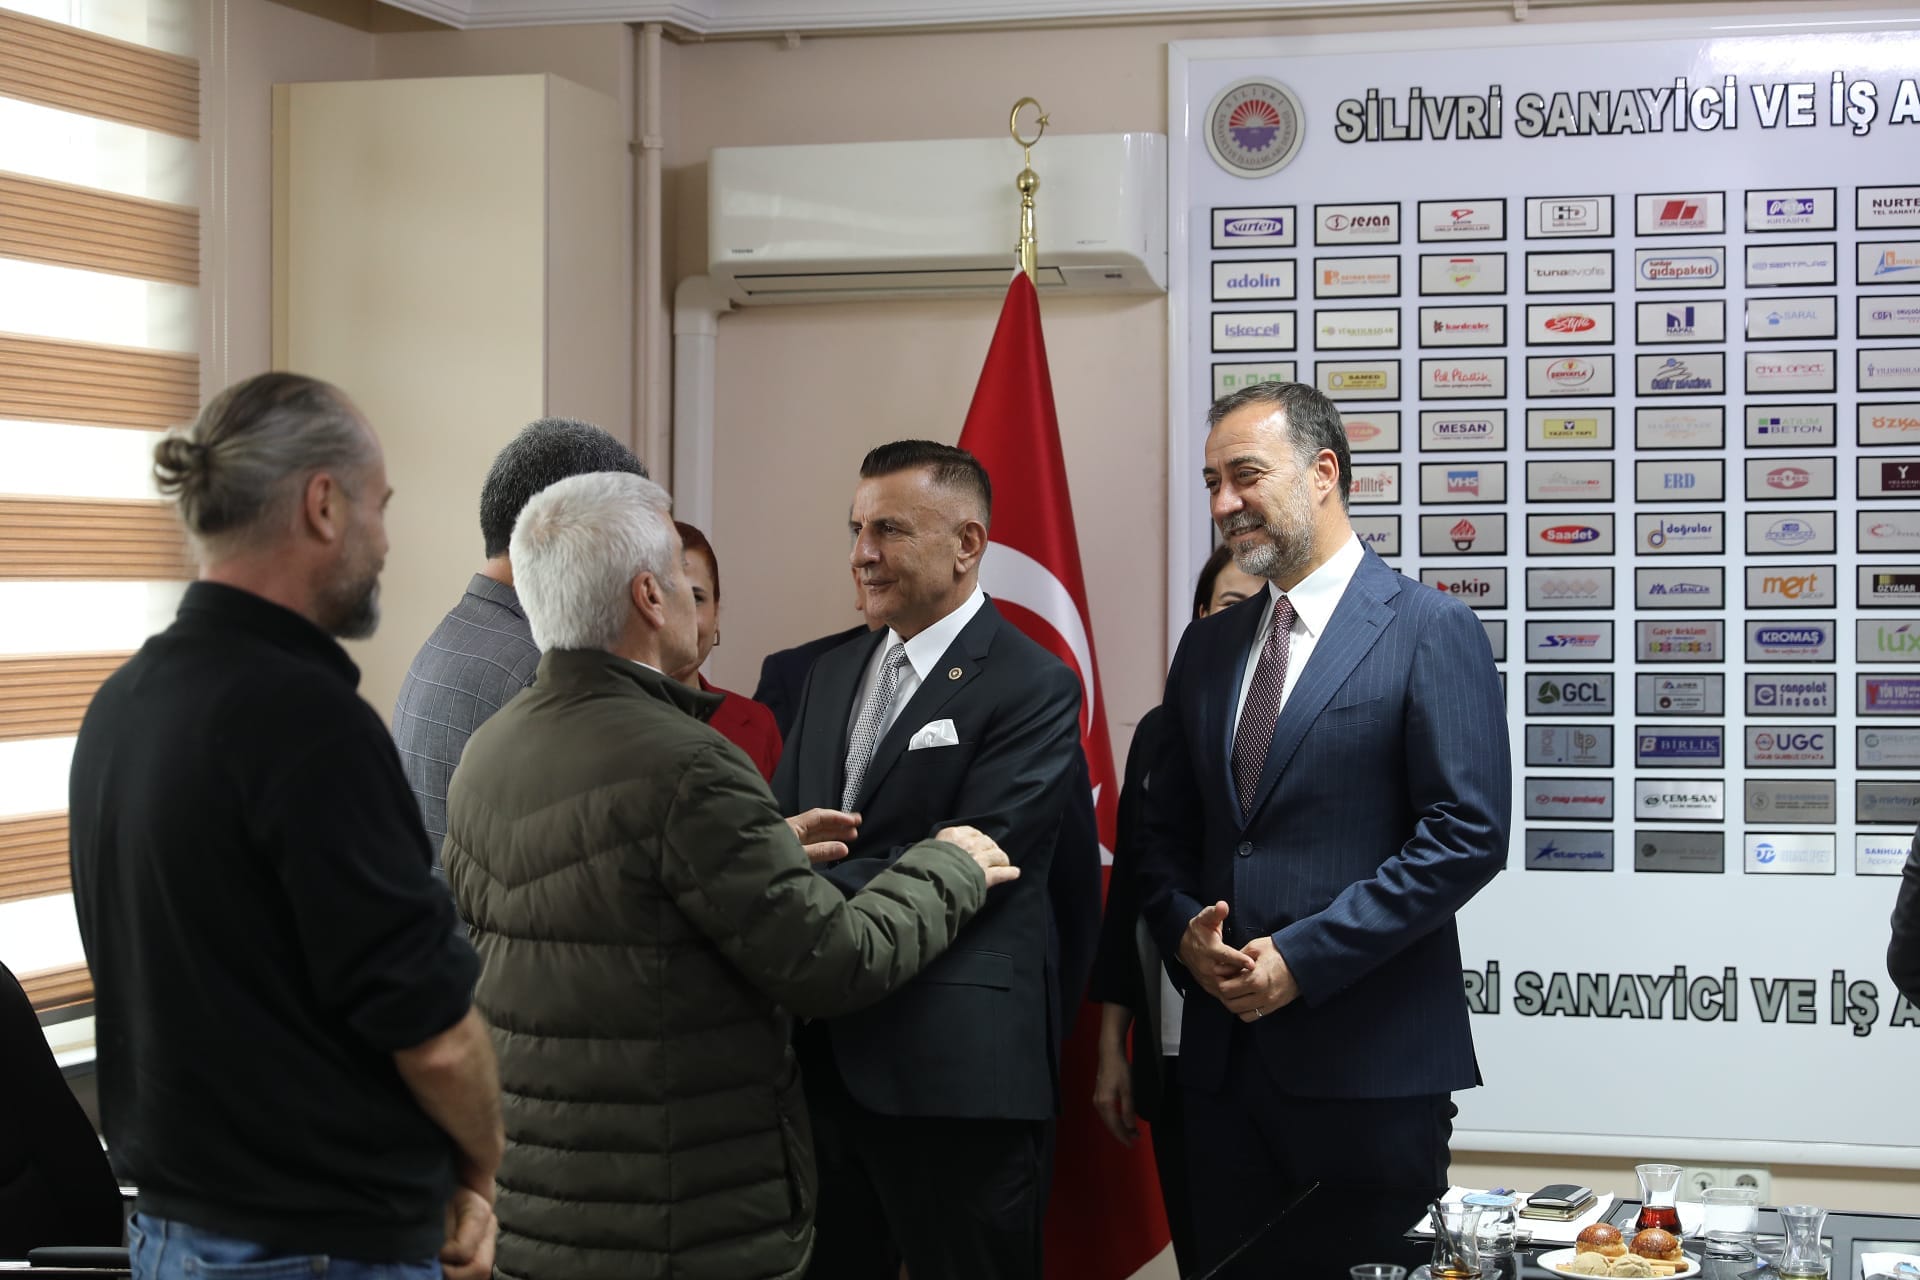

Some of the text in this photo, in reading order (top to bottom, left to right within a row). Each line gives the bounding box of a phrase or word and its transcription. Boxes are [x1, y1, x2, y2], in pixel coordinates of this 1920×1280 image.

[1335, 85, 1502, 143] SİLİVRİ
[1515, 76, 1738, 138] SANAYİCİ
[1750, 82, 1817, 128] VE
[1830, 71, 1878, 136] İŞ
[1231, 219, 1277, 233] sarten
[1226, 273, 1281, 289] adolin
[1439, 423, 1487, 434] MESAN
[1771, 425, 1823, 434] BETON
[1663, 473, 1696, 489] ERD
[1546, 528, 1593, 541] Saadet
[1666, 522, 1713, 536] doğrular
[1450, 578, 1490, 597] ekip
[1762, 572, 1818, 599] mert
[1761, 631, 1820, 645] KROMAŞ
[1562, 682, 1607, 702] GCL
[1660, 738, 1717, 750] BİRLİK
[1776, 733, 1825, 751] UGC
[1513, 965, 1738, 1022] SANAYİCİ
[1750, 977, 1817, 1024] VE
[1830, 970, 1879, 1036] İŞ
